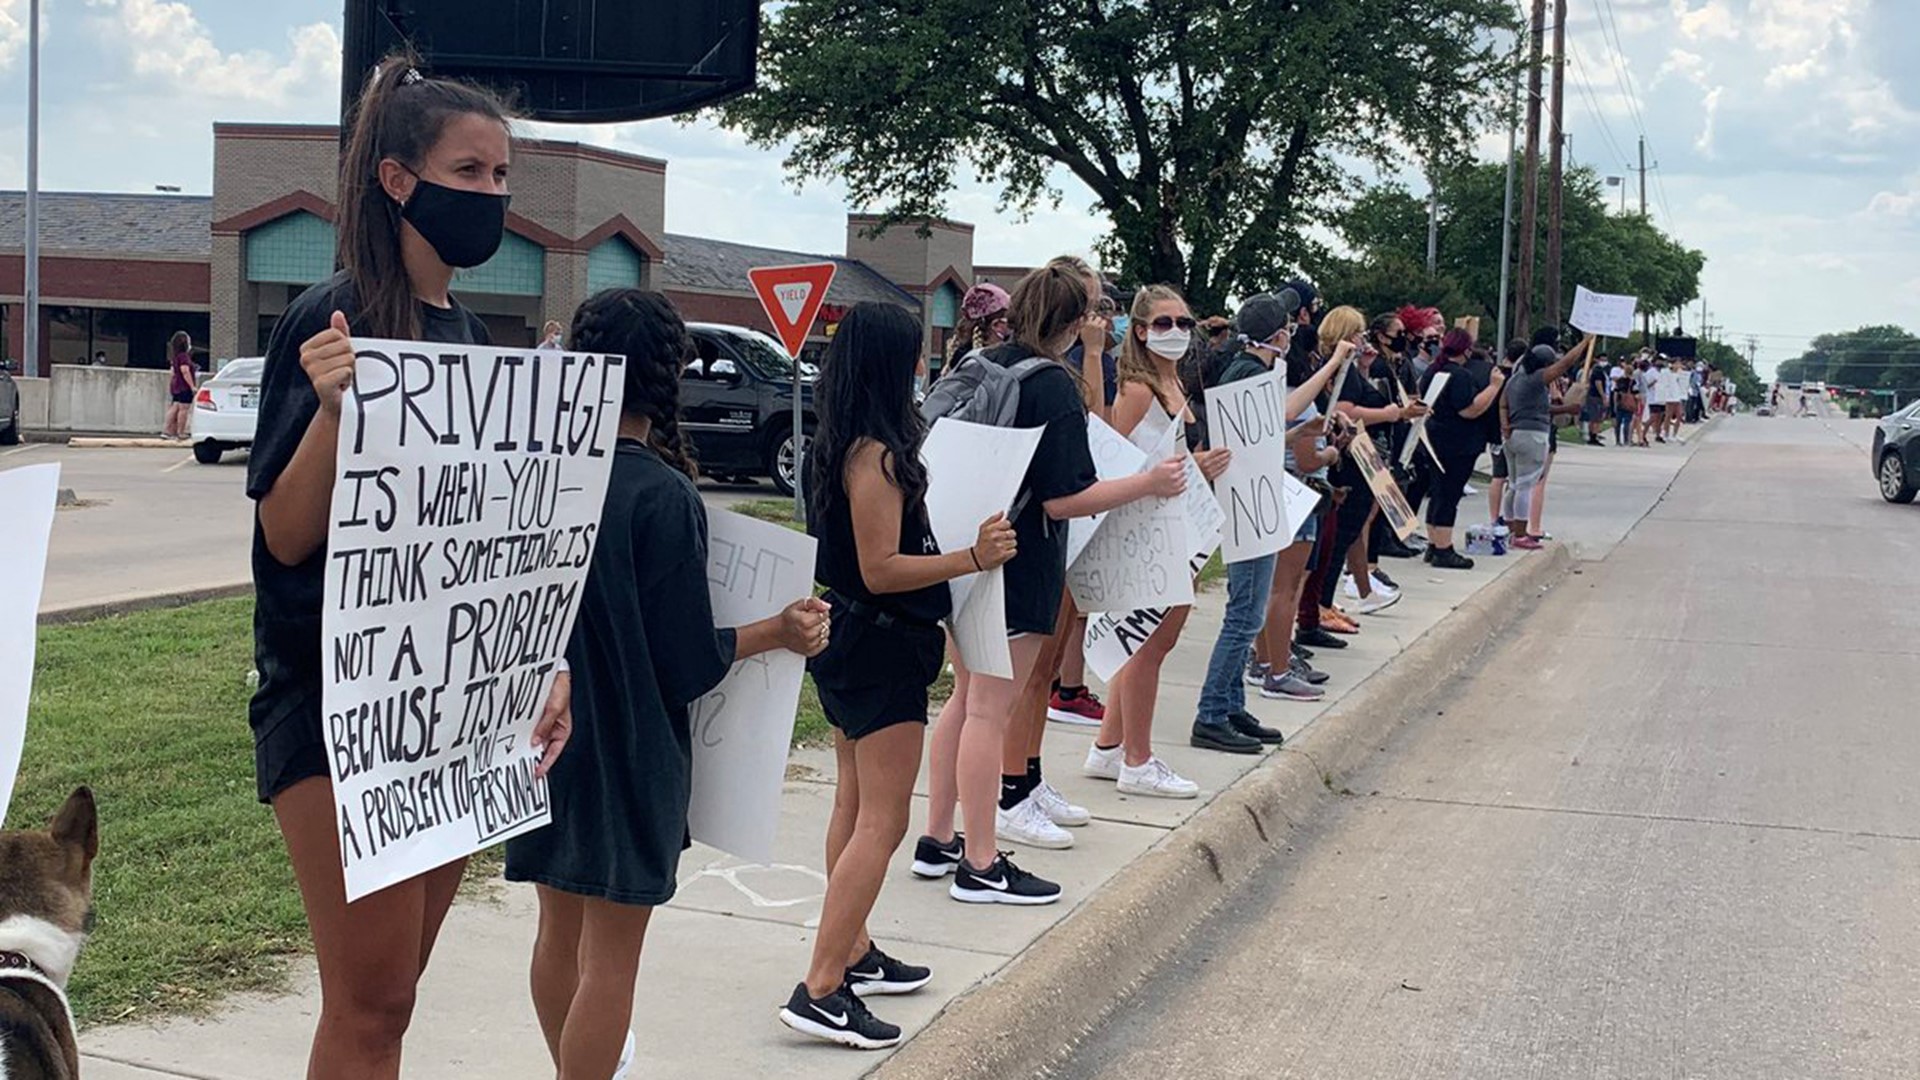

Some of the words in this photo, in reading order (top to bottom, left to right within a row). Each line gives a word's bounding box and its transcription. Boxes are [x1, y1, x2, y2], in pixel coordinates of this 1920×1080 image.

[780, 288, 806, 301] YIELD
[352, 350, 624, 458] PRIVILEGE
[338, 466, 400, 533] IS
[417, 462, 487, 527] WHEN
[1230, 474, 1280, 548] NO
[333, 541, 434, 610] THINK
[441, 530, 558, 590] SOMETHING
[556, 523, 596, 569] IS
[334, 626, 386, 684] NOT
[388, 625, 423, 682] A
[444, 580, 579, 685] PROBLEM
[330, 685, 446, 783] BECAUSE
[496, 662, 555, 731] NOT
[341, 804, 362, 868] A
[361, 765, 453, 856] PROBLEM
[449, 755, 471, 819] TO
